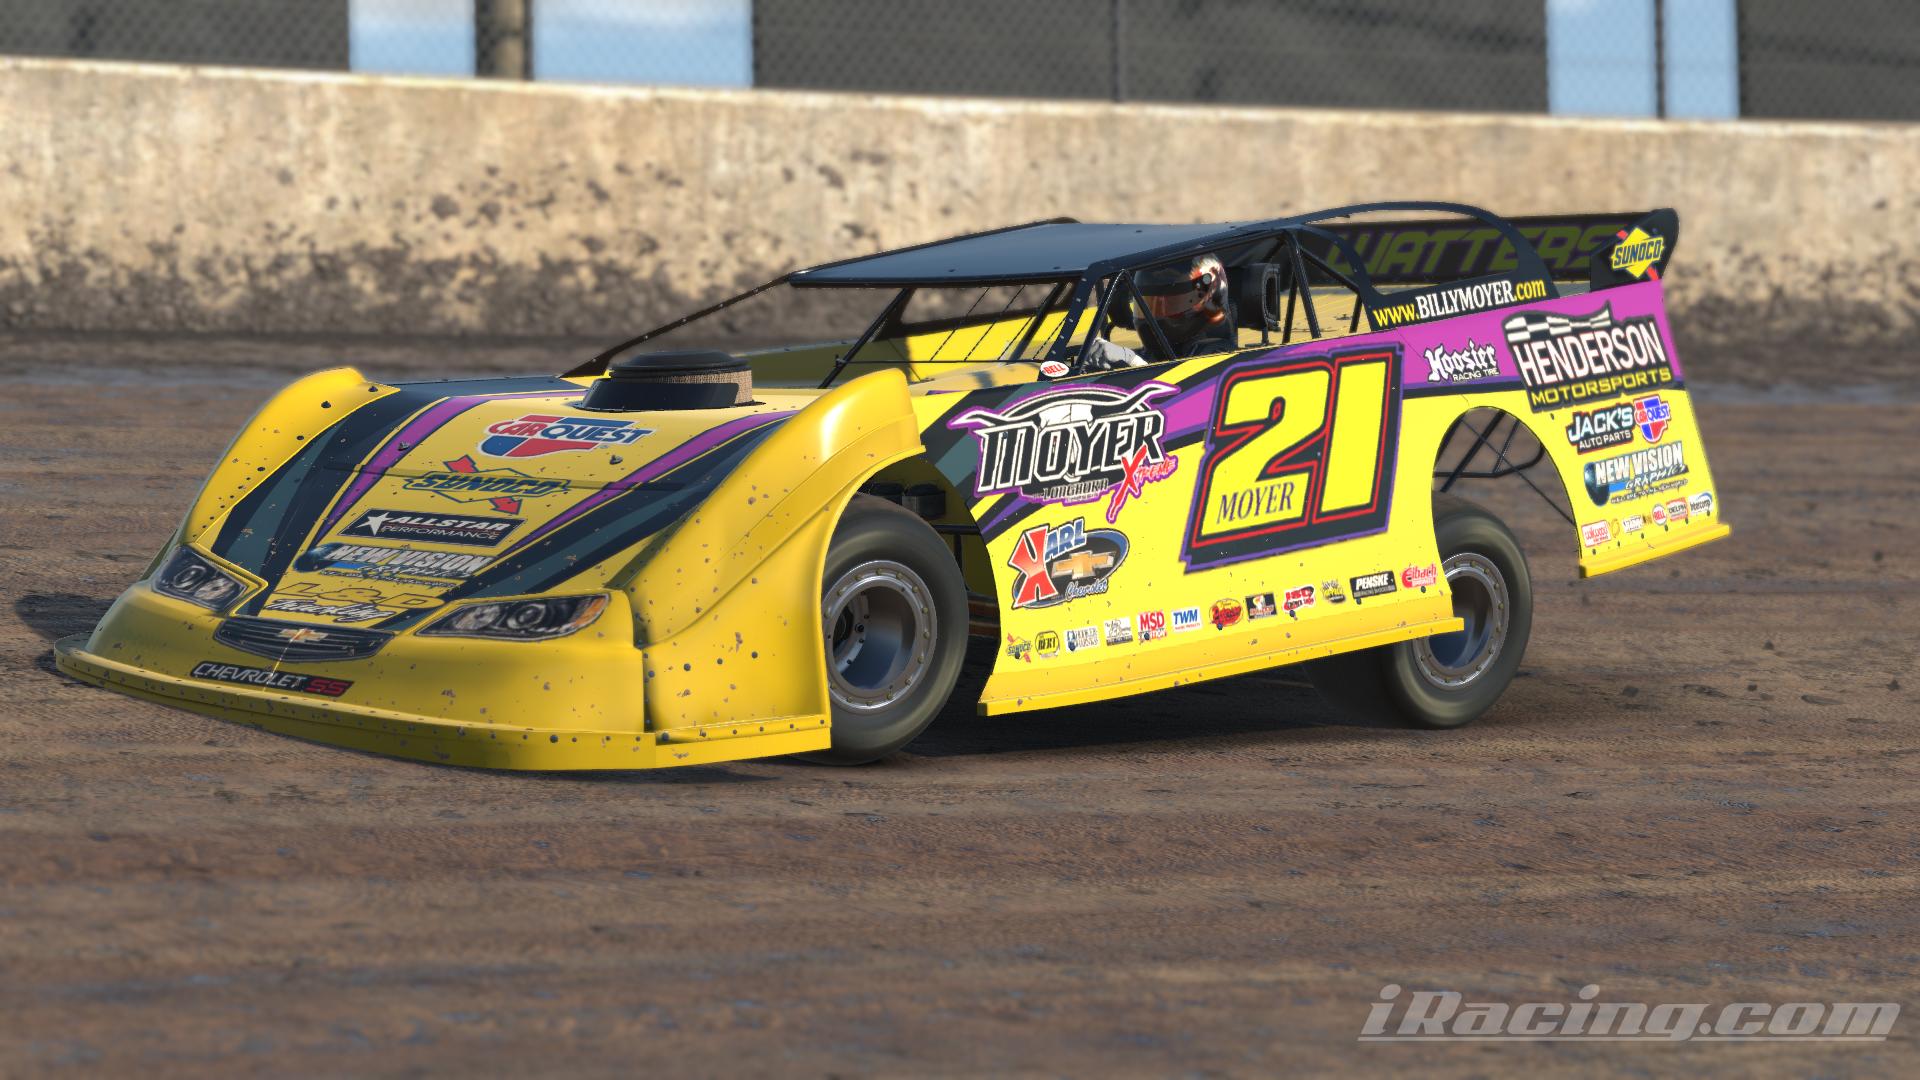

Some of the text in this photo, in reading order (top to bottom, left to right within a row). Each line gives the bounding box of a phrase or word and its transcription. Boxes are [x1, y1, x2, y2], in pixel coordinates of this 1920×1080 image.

[1613, 237, 1663, 267] SUNOCO
[1373, 279, 1546, 327] www.BILLYMOYER.com
[1425, 339, 1497, 382] Hoosier
[1513, 322, 1667, 386] HENDERSON
[1043, 364, 1066, 374] BELL
[1452, 370, 1482, 382] RACING
[1531, 368, 1672, 405] MOTORSPORTS
[489, 420, 654, 444] CARQUEST
[1568, 406, 1633, 442] JACK'S
[973, 410, 1165, 492] MOYER
[1193, 353, 1392, 547] 21
[1579, 430, 1632, 449] AUTO PARTS
[1595, 442, 1683, 485] NEW VISION
[411, 474, 563, 495] SUNOCO
[1216, 482, 1295, 524] MOYER
[381, 525, 501, 540] PERFORMANCE
[391, 516, 511, 531] ALLSTAR
[323, 545, 495, 573] NEW VISION
[1356, 573, 1389, 591] PENSKE
[1140, 611, 1165, 631] MSD
[1173, 609, 1198, 625] TWM
[193, 663, 351, 695] CHEVROLET SS
